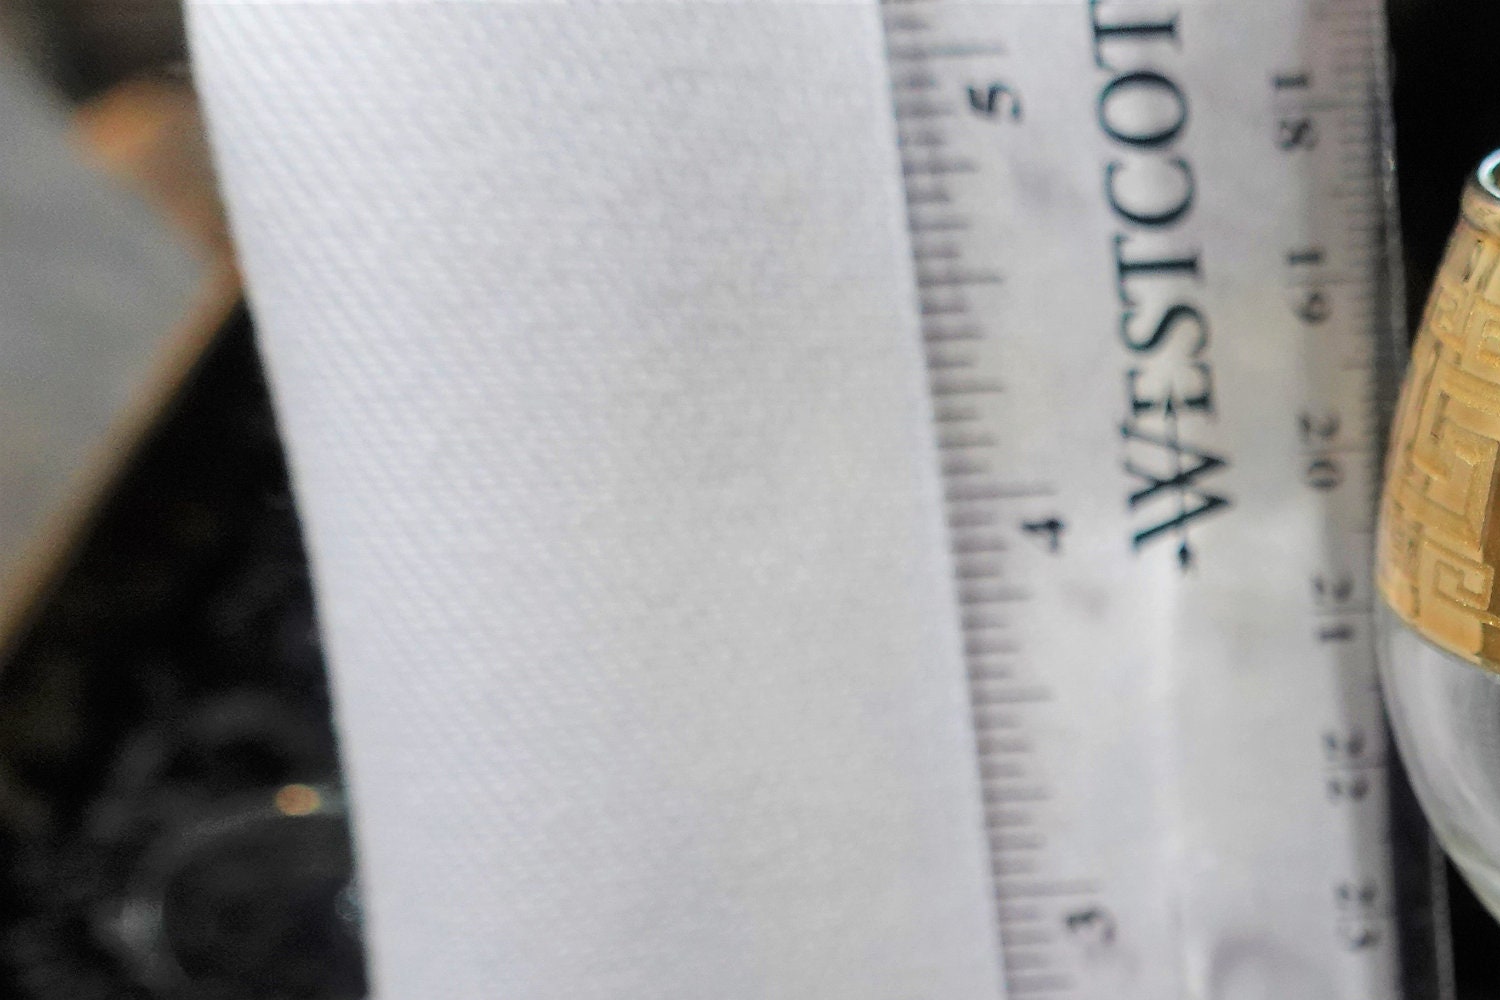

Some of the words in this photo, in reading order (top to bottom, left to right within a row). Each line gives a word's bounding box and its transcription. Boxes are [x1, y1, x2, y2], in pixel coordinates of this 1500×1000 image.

[968, 81, 1022, 122] 5
[1272, 71, 1316, 151] 18
[1286, 249, 1332, 324] 19
[1302, 412, 1342, 489] 20
